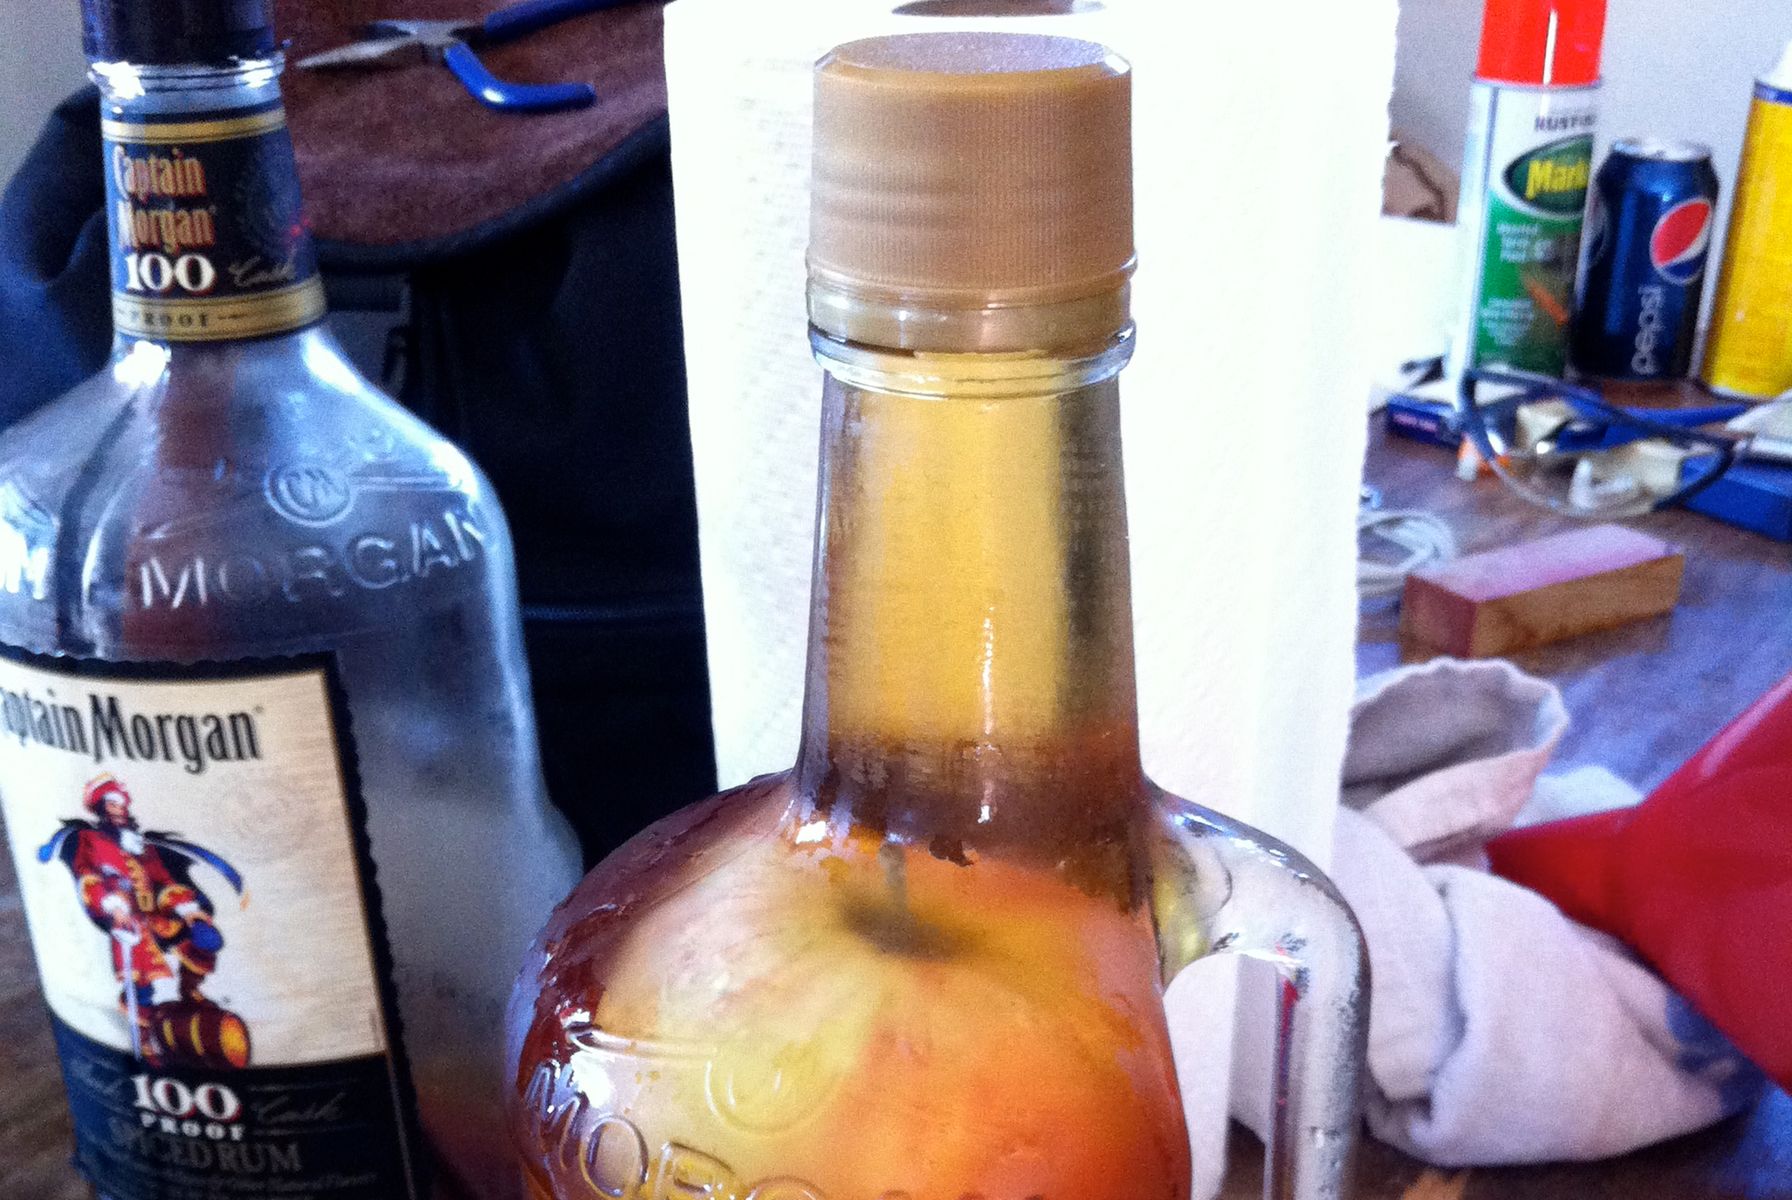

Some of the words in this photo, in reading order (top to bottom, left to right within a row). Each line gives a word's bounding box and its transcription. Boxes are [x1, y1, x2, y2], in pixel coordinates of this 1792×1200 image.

[125, 252, 216, 292] 100
[88, 692, 262, 775] Morgan
[130, 1073, 242, 1124] 100
[140, 1112, 246, 1141] PROOF
[216, 1141, 304, 1173] RUM
